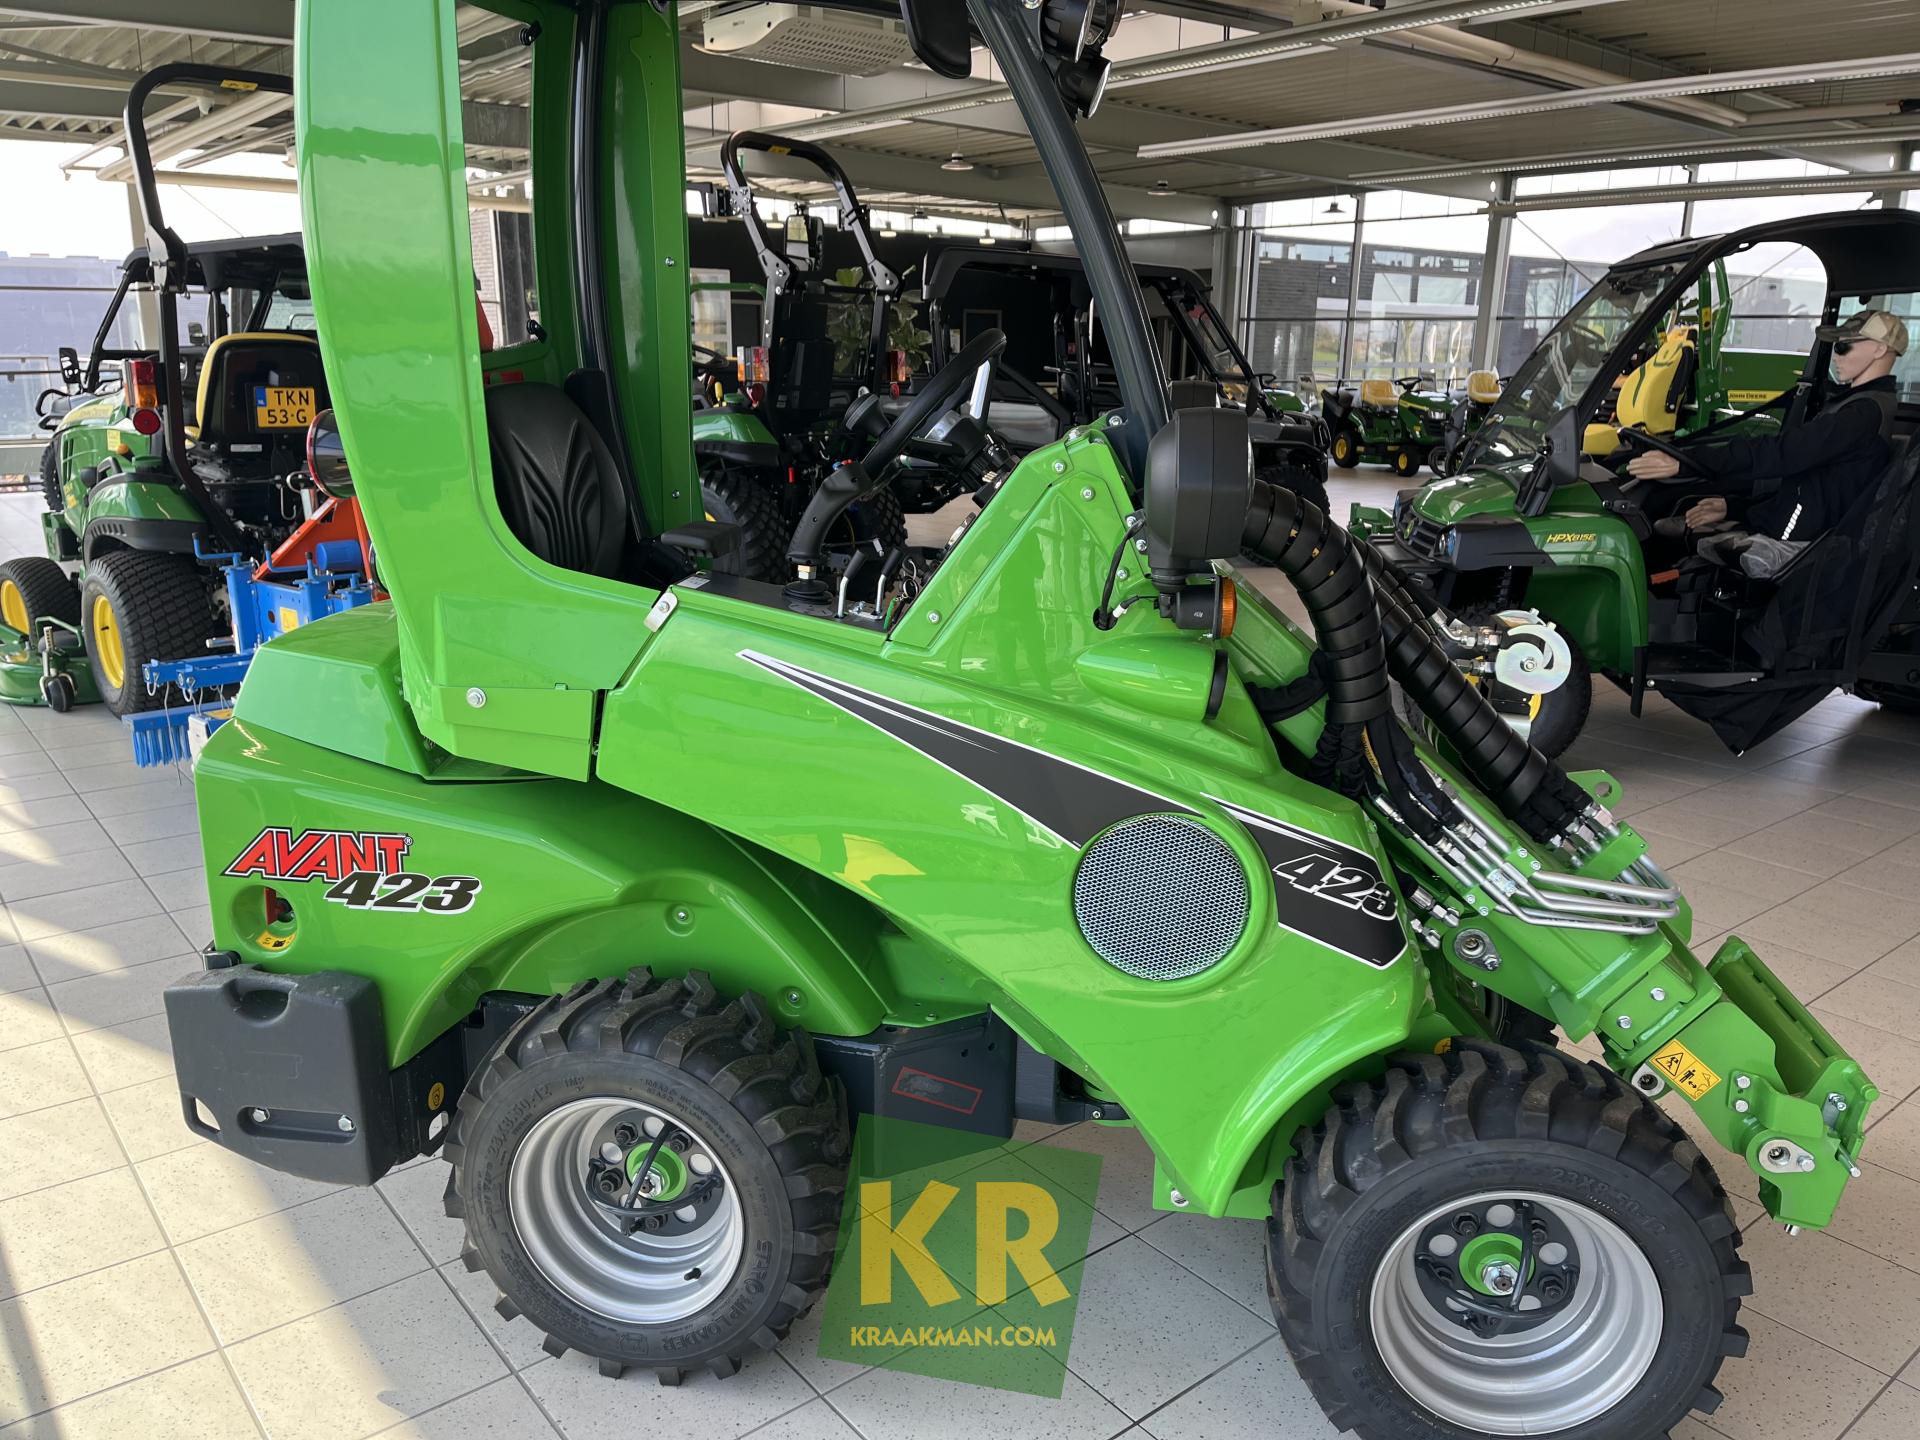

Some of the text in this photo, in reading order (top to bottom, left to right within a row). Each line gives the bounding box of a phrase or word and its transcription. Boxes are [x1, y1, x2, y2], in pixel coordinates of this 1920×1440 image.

[273, 390, 310, 406] TKN
[323, 871, 482, 915] 423
[1273, 853, 1399, 921] 423
